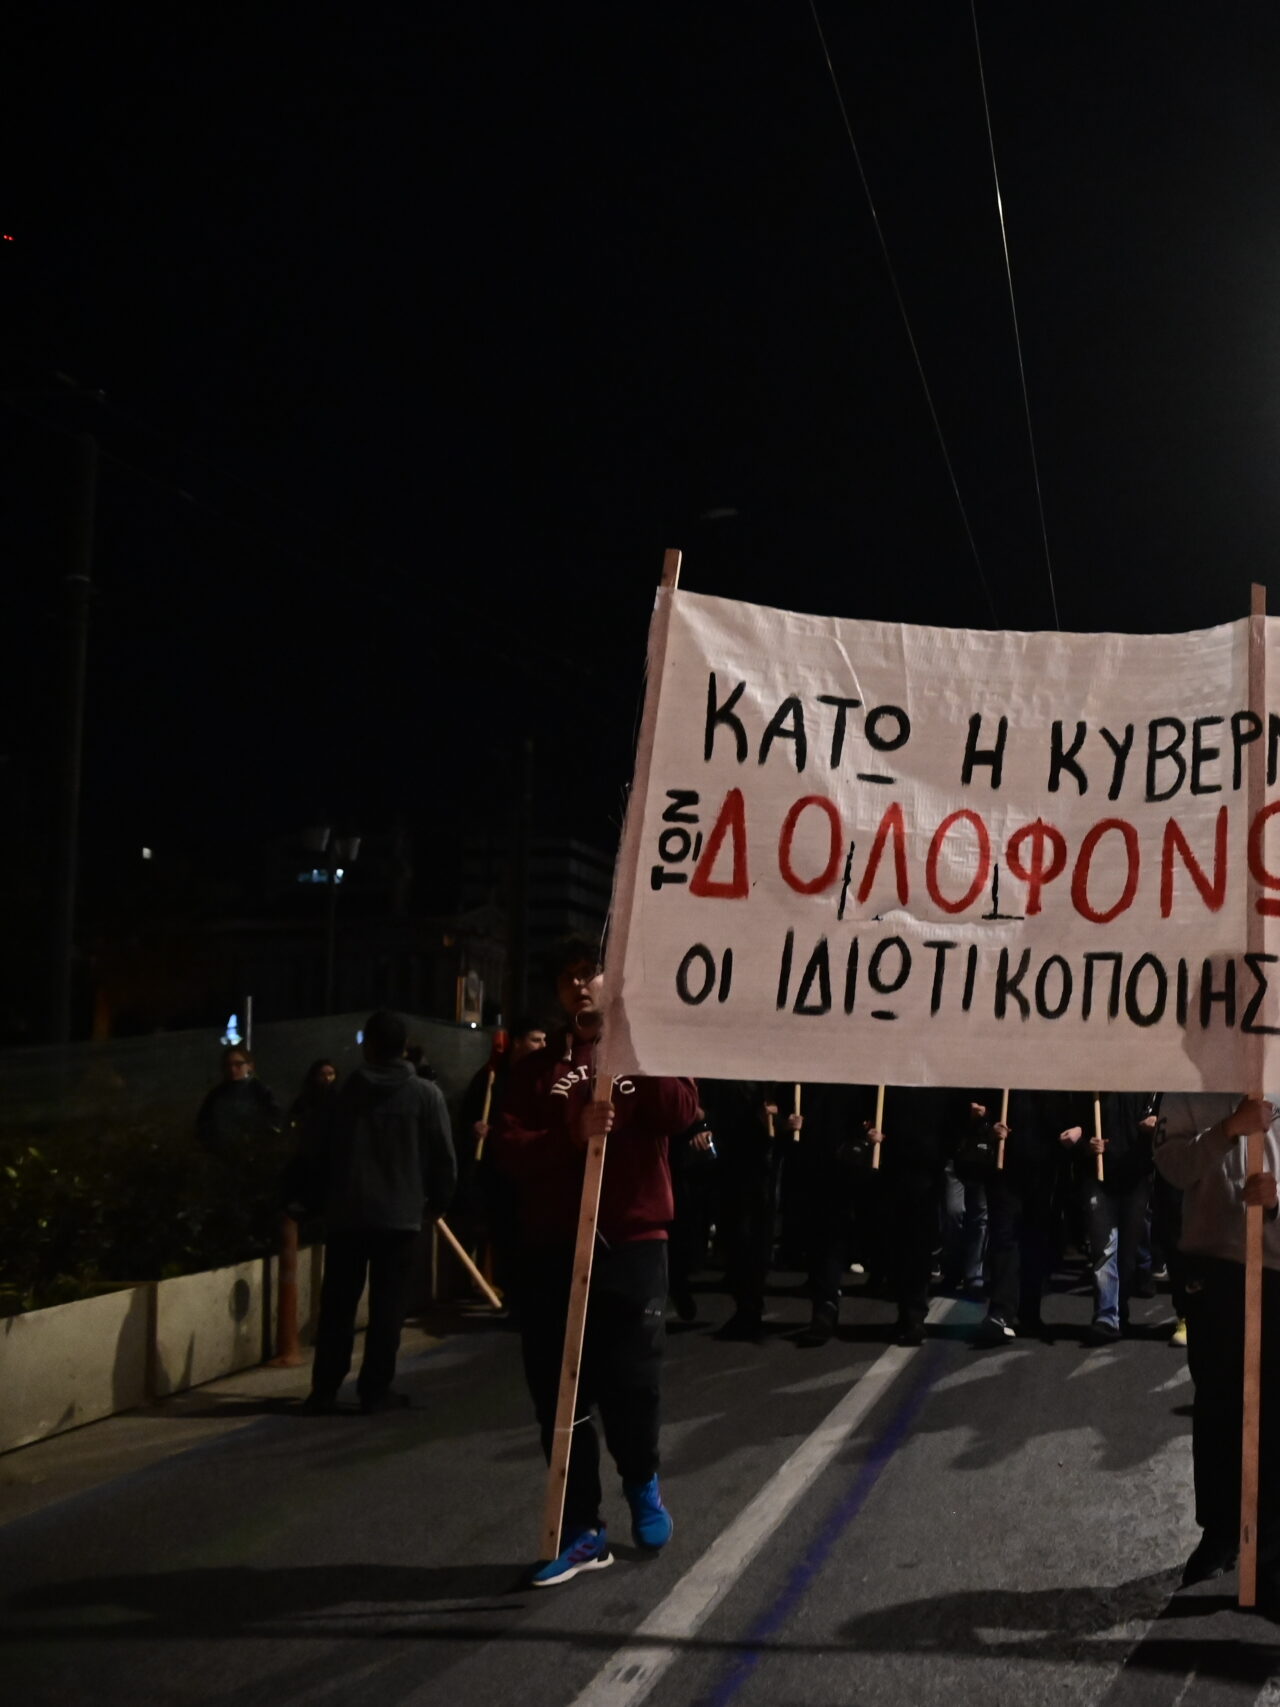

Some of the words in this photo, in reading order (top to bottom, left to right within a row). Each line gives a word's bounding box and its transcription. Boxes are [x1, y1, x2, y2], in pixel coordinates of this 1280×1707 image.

[960, 712, 1009, 790] Η
[675, 942, 733, 1006] ΟΙ
[550, 1064, 589, 1099] JUST
